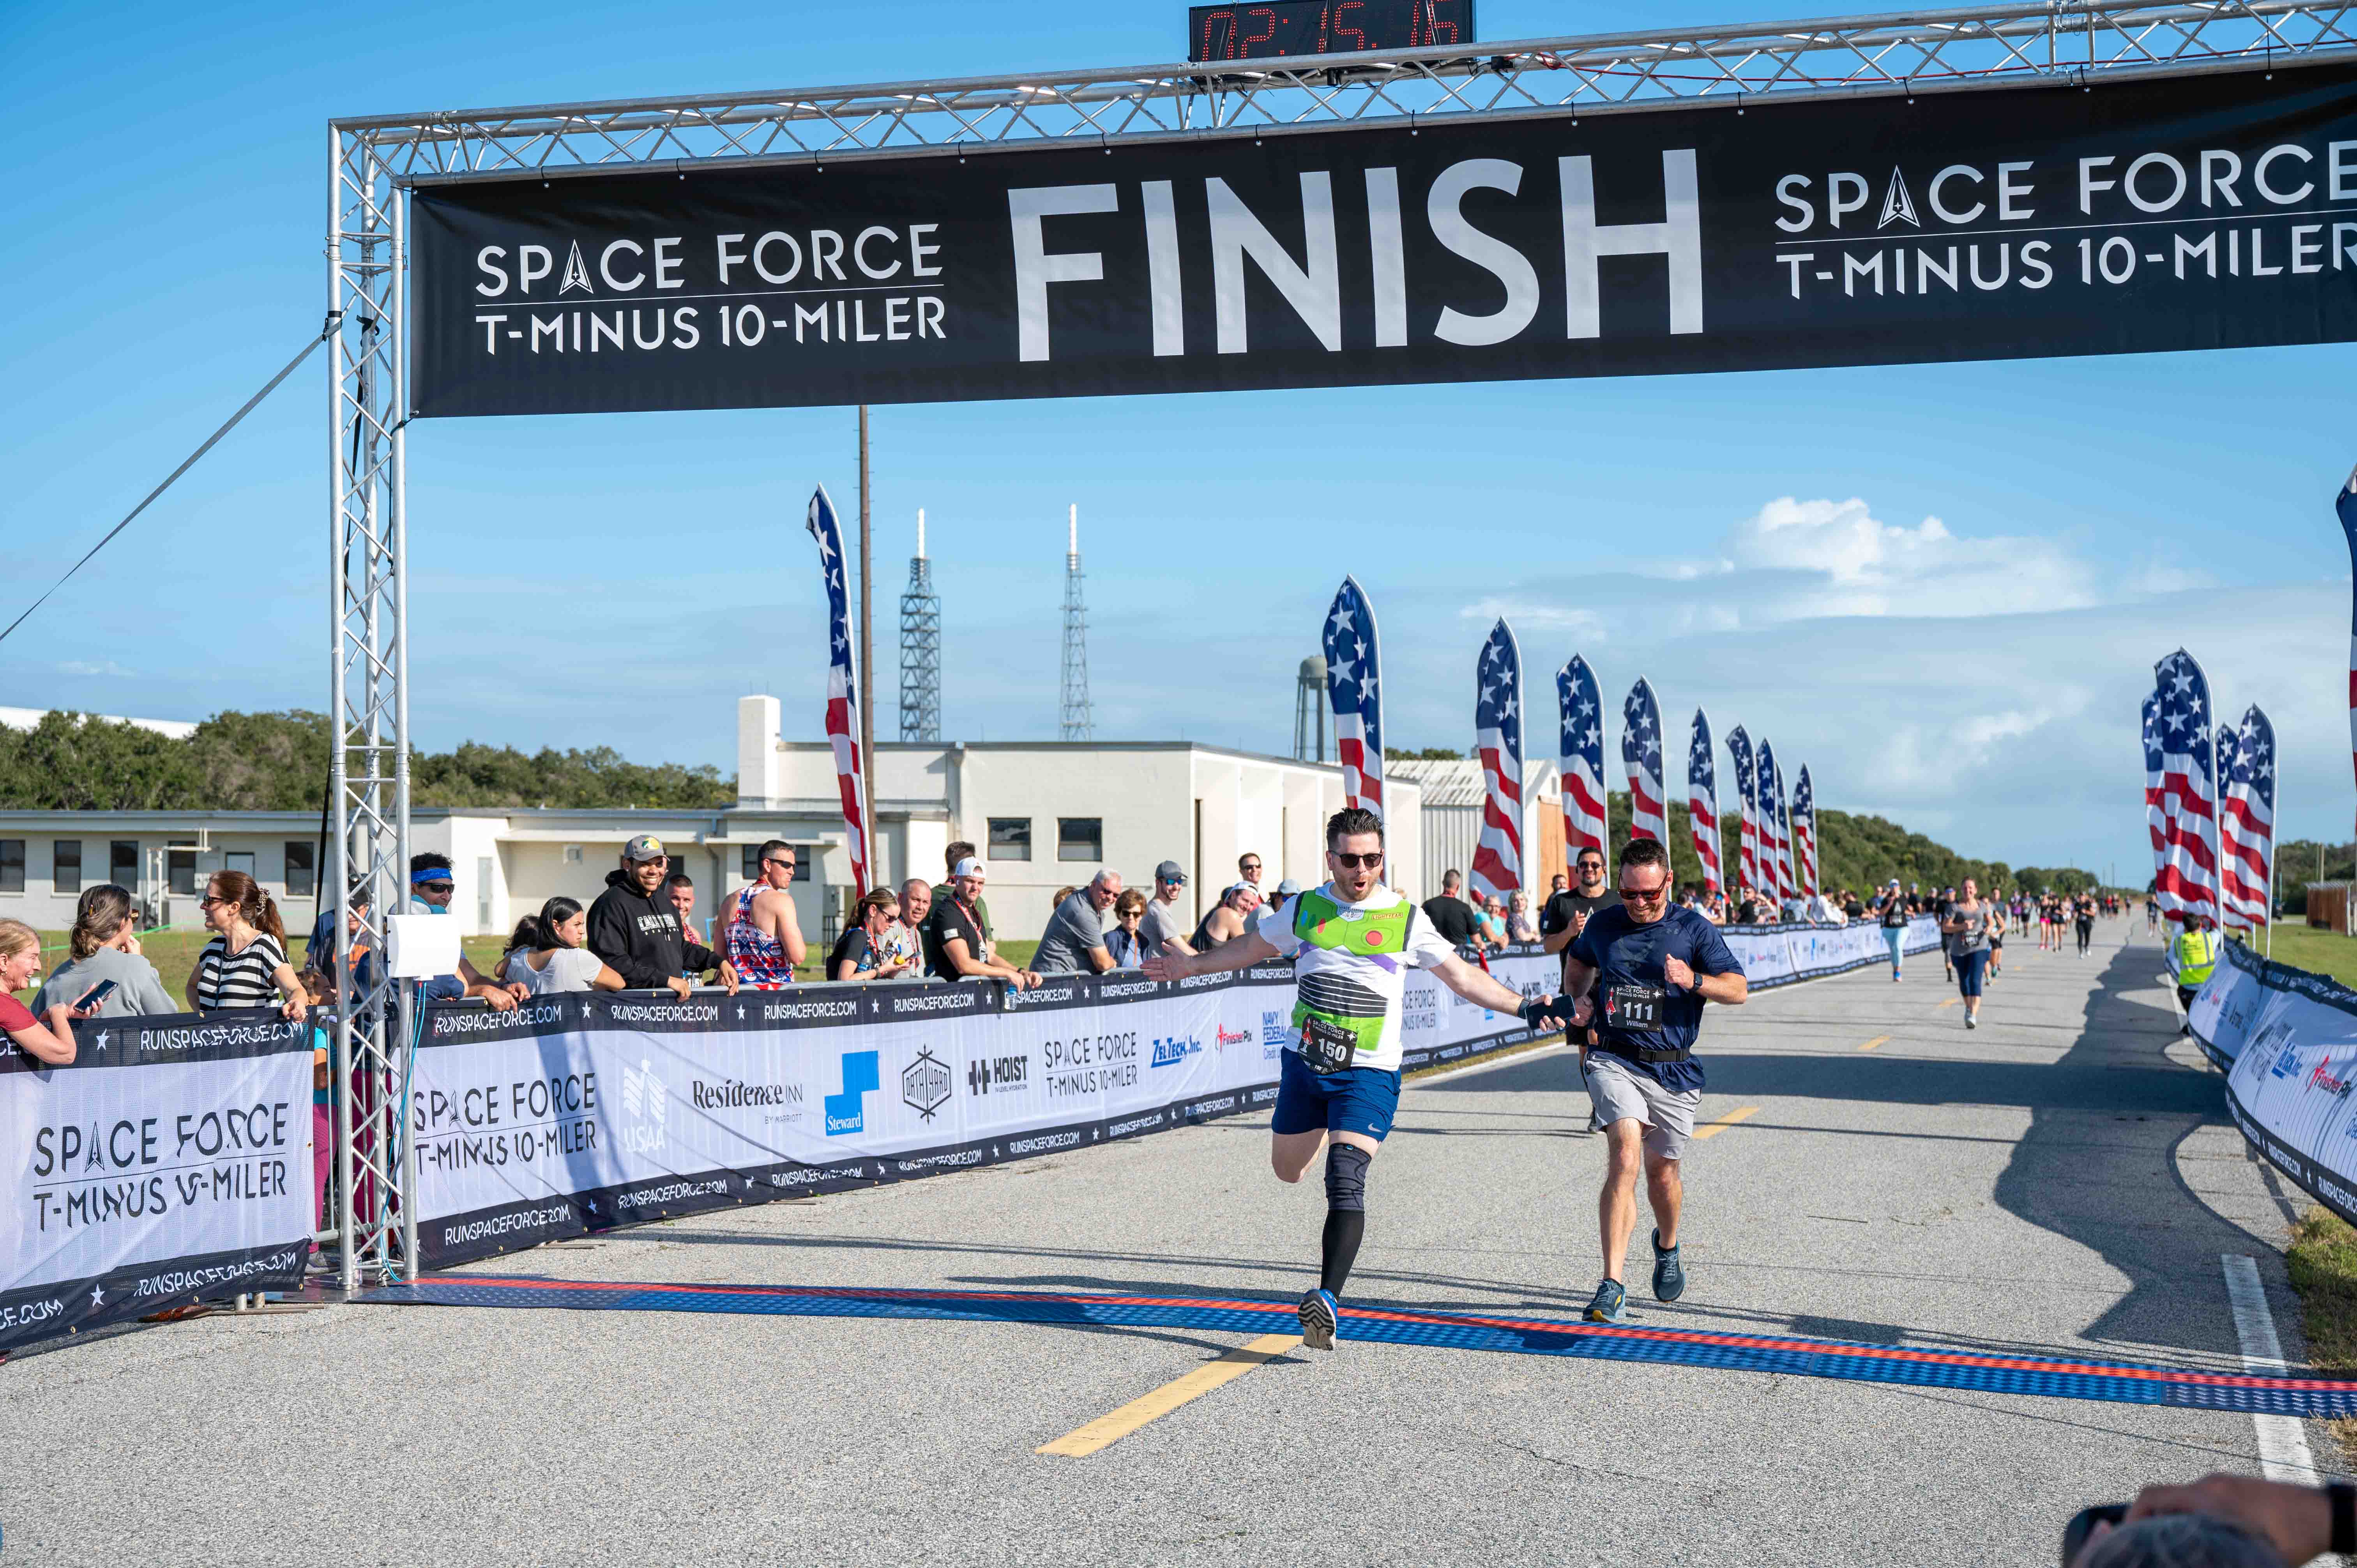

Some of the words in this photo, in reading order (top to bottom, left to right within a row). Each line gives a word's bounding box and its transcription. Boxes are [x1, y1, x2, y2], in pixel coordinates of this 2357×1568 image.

[1775, 160, 2035, 233] SPACE
[2079, 140, 2357, 215] FORCE
[475, 237, 684, 297] SPACE
[717, 223, 943, 286] FORCE
[1007, 148, 1703, 363] FINISH
[1775, 239, 2053, 300] T-MINUS
[2078, 222, 2357, 285] 10-MILER
[475, 307, 700, 355] T-MINUS
[718, 296, 947, 347] 10-MILER
[1101, 981, 1157, 998] RUNSPACEFORCE.COM
[1180, 970, 1232, 988] RUNSPACEFORCE.COM
[611, 1005, 717, 1021] RUNSPACEFORCE.COM
[765, 1001, 856, 1020] RUNSPACEFORCE.COM
[894, 993, 974, 1012] RUNSPACEFORCE.COM
[1624, 1002, 1652, 1020] 111
[435, 1005, 561, 1033] RUNSPACEFORCE.COM
[1263, 1012, 1278, 1026] NAVY
[1313, 1020, 1327, 1029] SPACE
[1328, 1026, 1344, 1035] FORCE
[1626, 1020, 1648, 1028] William
[141, 1022, 303, 1051] RUNSPACEFORCE.COM
[1223, 1030, 1252, 1046] FinisherPix
[1313, 1025, 1327, 1034] T-MINUS
[1327, 1031, 1343, 1040] 10-MILER
[1045, 1038, 1090, 1068] SPACE
[1097, 1032, 1136, 1061] FORCE
[1318, 1038, 1346, 1062] 150
[1323, 1056, 1333, 1066] Tim
[994, 1056, 1027, 1084] HOIST
[1047, 1072, 1095, 1097] T-MINUS
[1100, 1065, 1137, 1090] 10-MILER
[692, 1079, 783, 1109] Residence
[906, 1068, 924, 1103] DATA
[928, 1066, 947, 1102] YARD
[415, 1085, 499, 1131] SPACE
[513, 1073, 595, 1119] FORCE
[1185, 1096, 1234, 1116] RUNSPACEFORCE.COM
[765, 1116, 773, 1124] BY
[775, 1114, 802, 1123] MARRIOTT
[828, 1112, 861, 1131] Steward
[34, 1118, 157, 1176] SPACE
[177, 1103, 288, 1159] FORCE
[514, 1120, 596, 1163] 10-MILER
[624, 1124, 666, 1153] USAA
[1010, 1132, 1080, 1154] RUNSPACEFORCE.COM
[34, 1177, 167, 1232] T-MINUS
